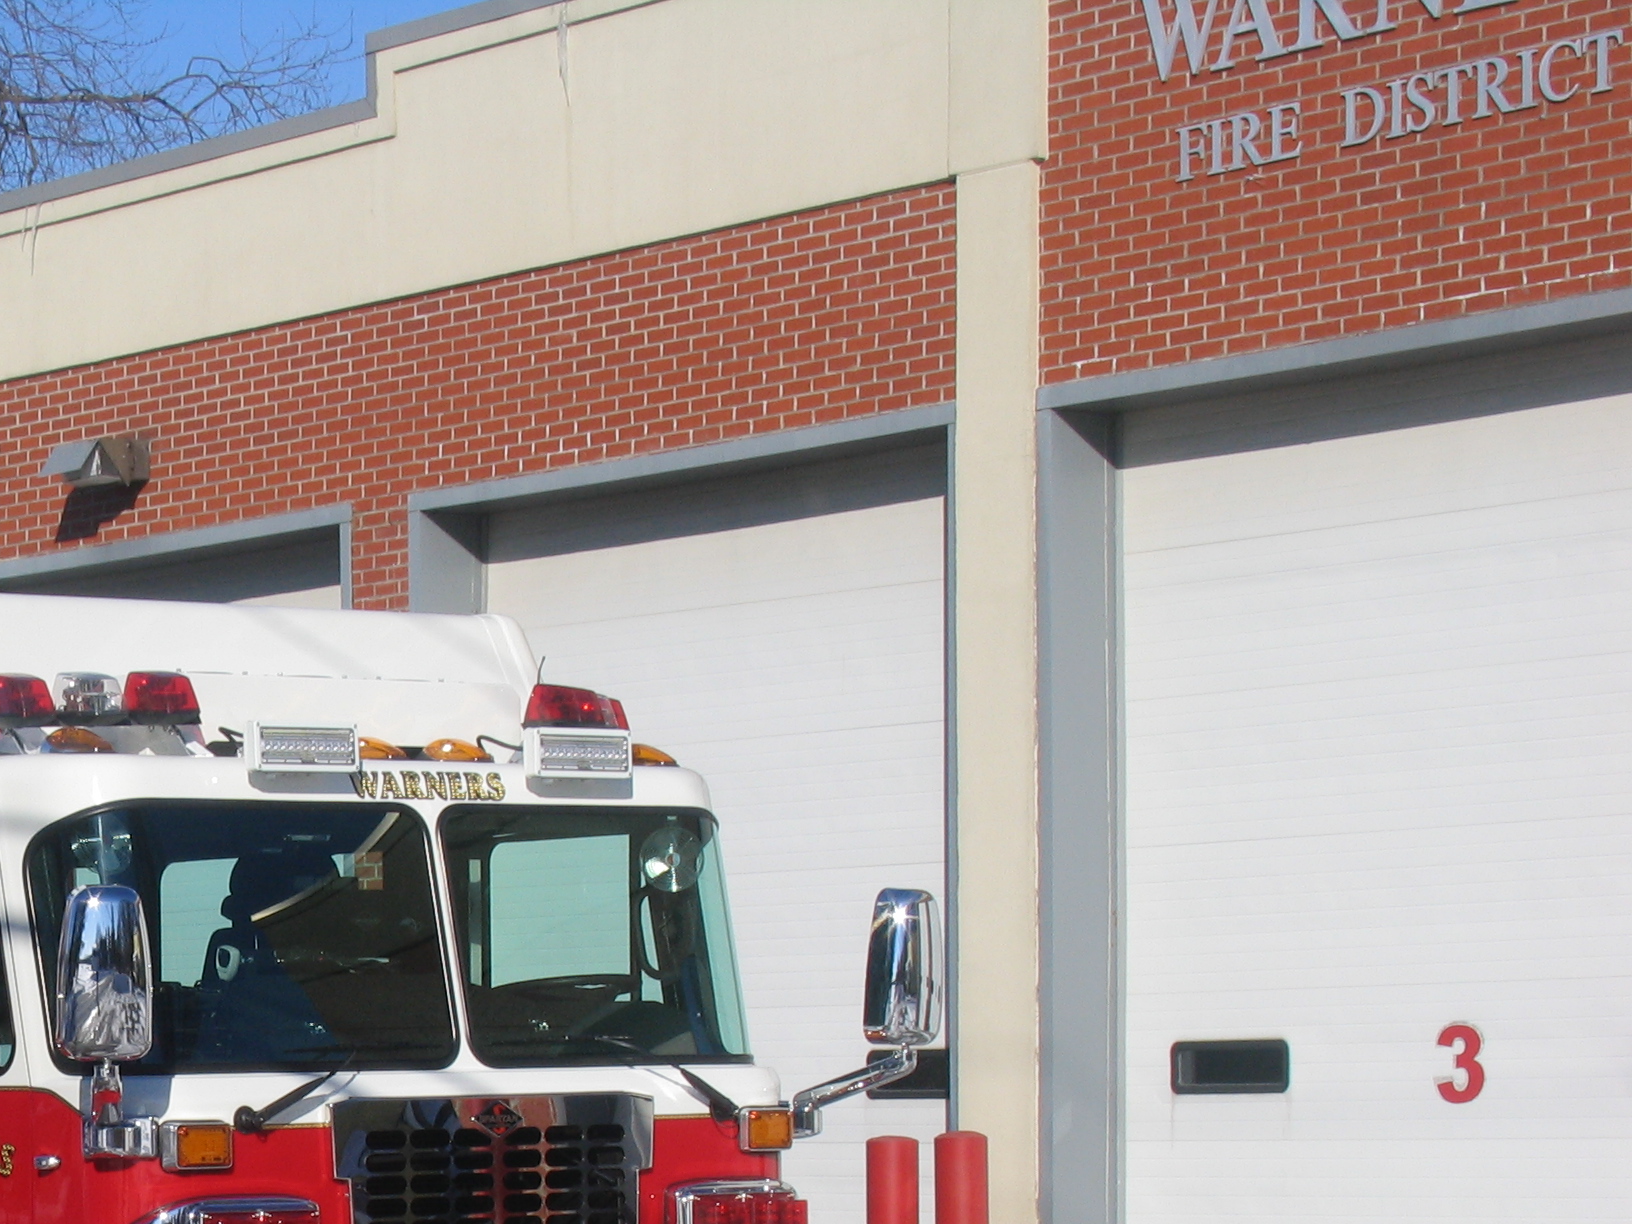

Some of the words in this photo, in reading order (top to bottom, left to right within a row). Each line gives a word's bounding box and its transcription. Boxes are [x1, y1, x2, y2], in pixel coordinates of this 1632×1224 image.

[1175, 101, 1303, 183] FIRE
[1340, 29, 1624, 148] DISTRICT
[348, 770, 506, 801] WARNERS
[1436, 1023, 1485, 1104] 3
